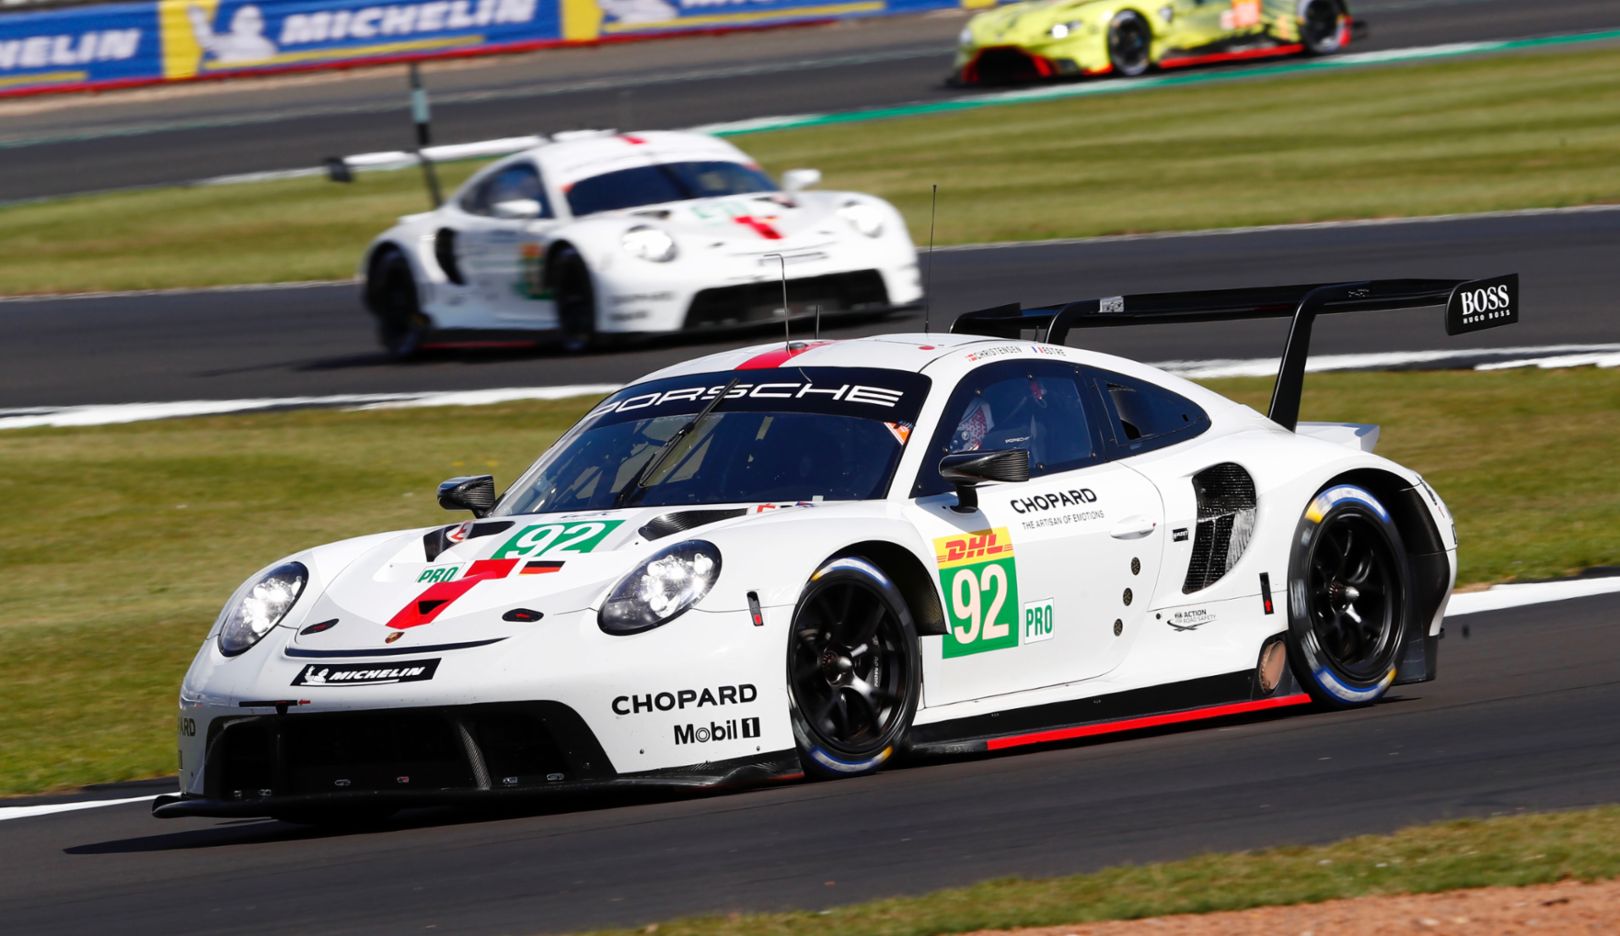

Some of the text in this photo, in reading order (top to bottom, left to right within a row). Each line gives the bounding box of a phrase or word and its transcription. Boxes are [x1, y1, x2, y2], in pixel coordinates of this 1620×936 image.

[279, 0, 538, 44] MICHELIN
[1461, 284, 1509, 315] BOSS
[1463, 309, 1510, 324] HUGO BOSS
[1010, 488, 1097, 514] CHOPARD
[1022, 510, 1105, 529] THE ARTISAN OF EMOTIONS
[504, 522, 606, 559] 92
[945, 534, 1004, 561] DHL
[417, 566, 460, 583] PRO
[951, 563, 1010, 644] 92
[1184, 609, 1207, 618] ACTION
[1026, 604, 1053, 638] PRO
[329, 666, 426, 681] MICHELIN
[611, 683, 757, 715] CHOPARD
[674, 717, 758, 745] Mobil 1
